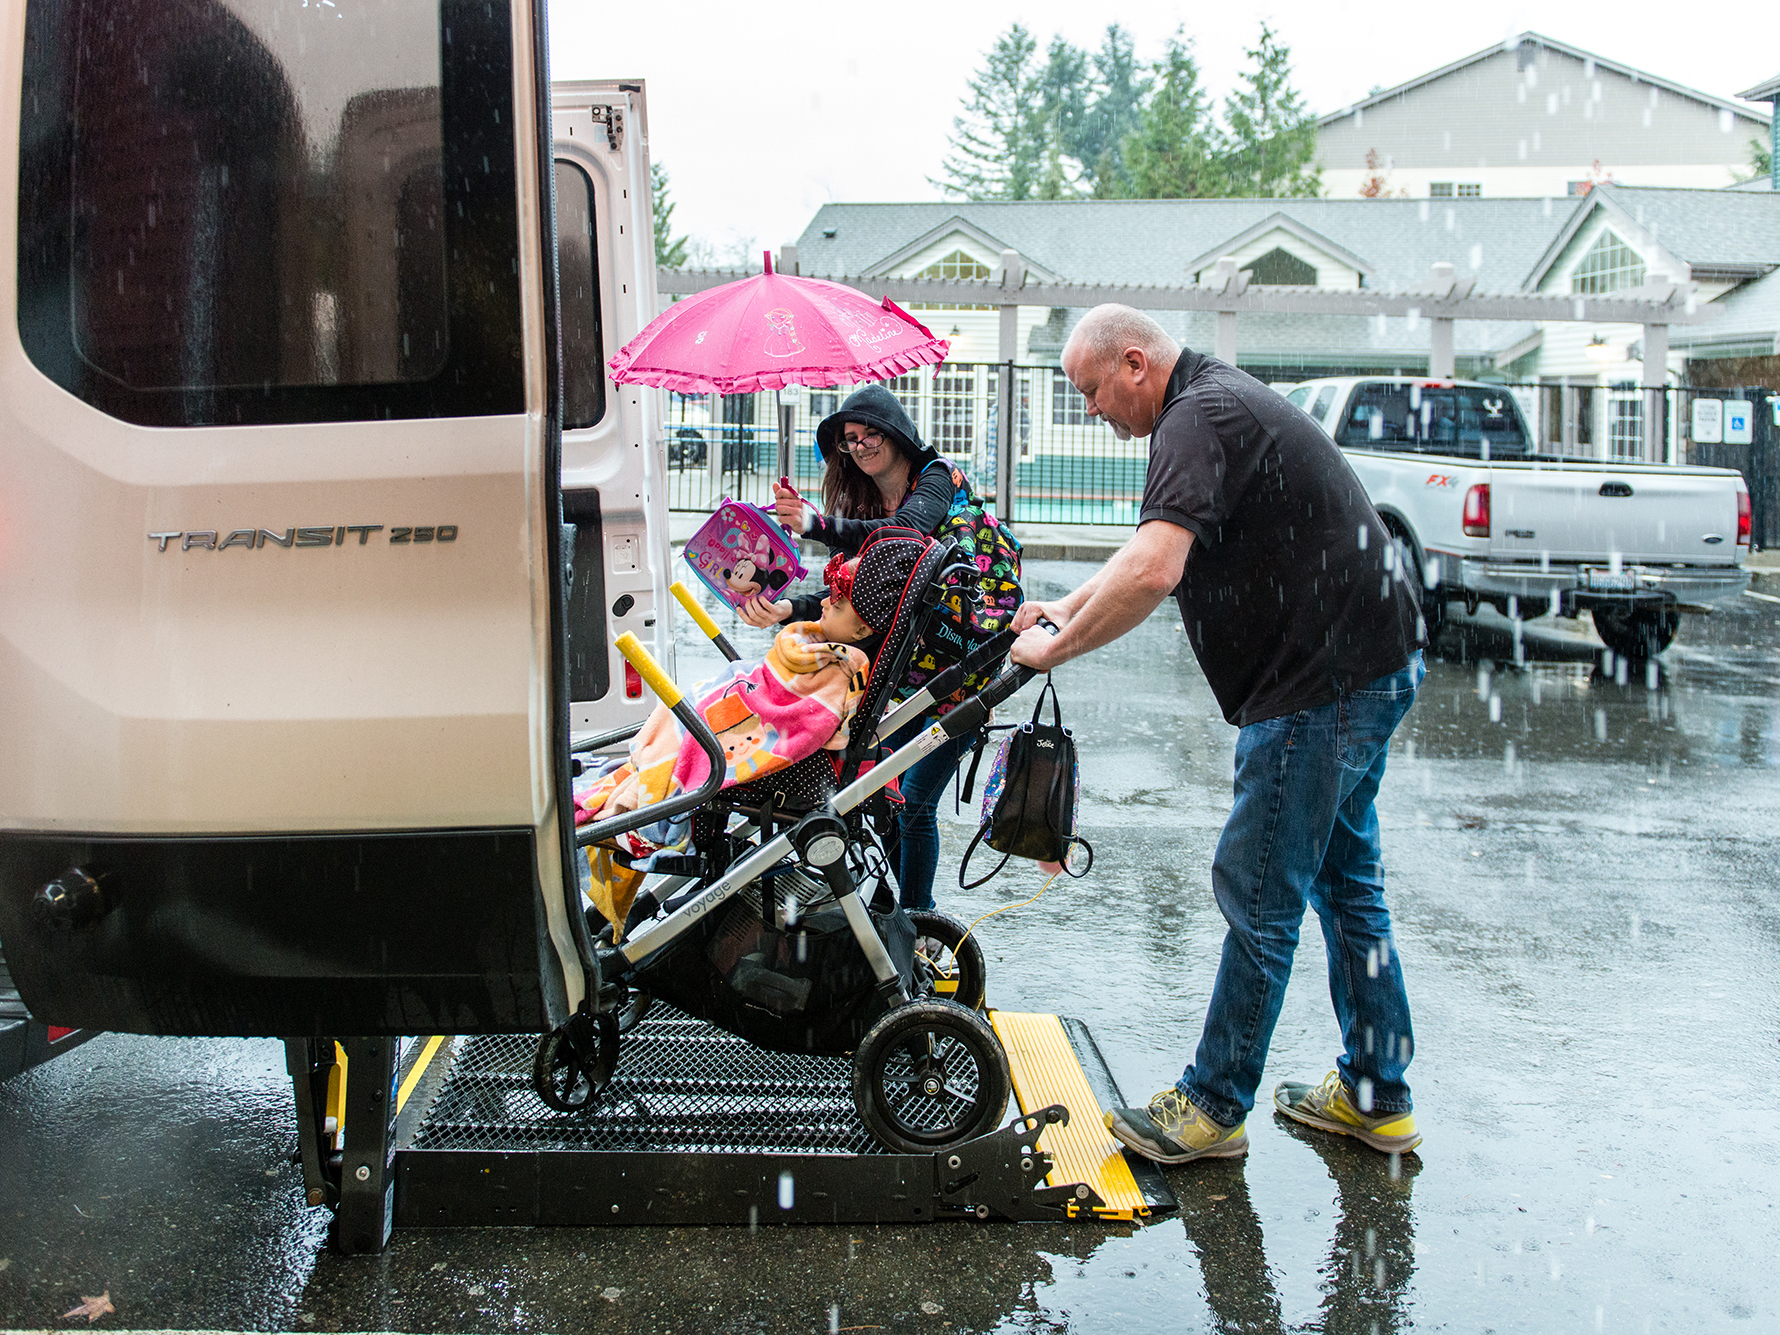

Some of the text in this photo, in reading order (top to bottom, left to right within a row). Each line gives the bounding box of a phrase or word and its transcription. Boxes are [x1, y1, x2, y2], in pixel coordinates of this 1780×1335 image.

[783, 388, 799, 396] 183
[1425, 474, 1460, 489] FX4
[147, 523, 458, 551] TRANSIT 250
[682, 881, 732, 918] voyage
